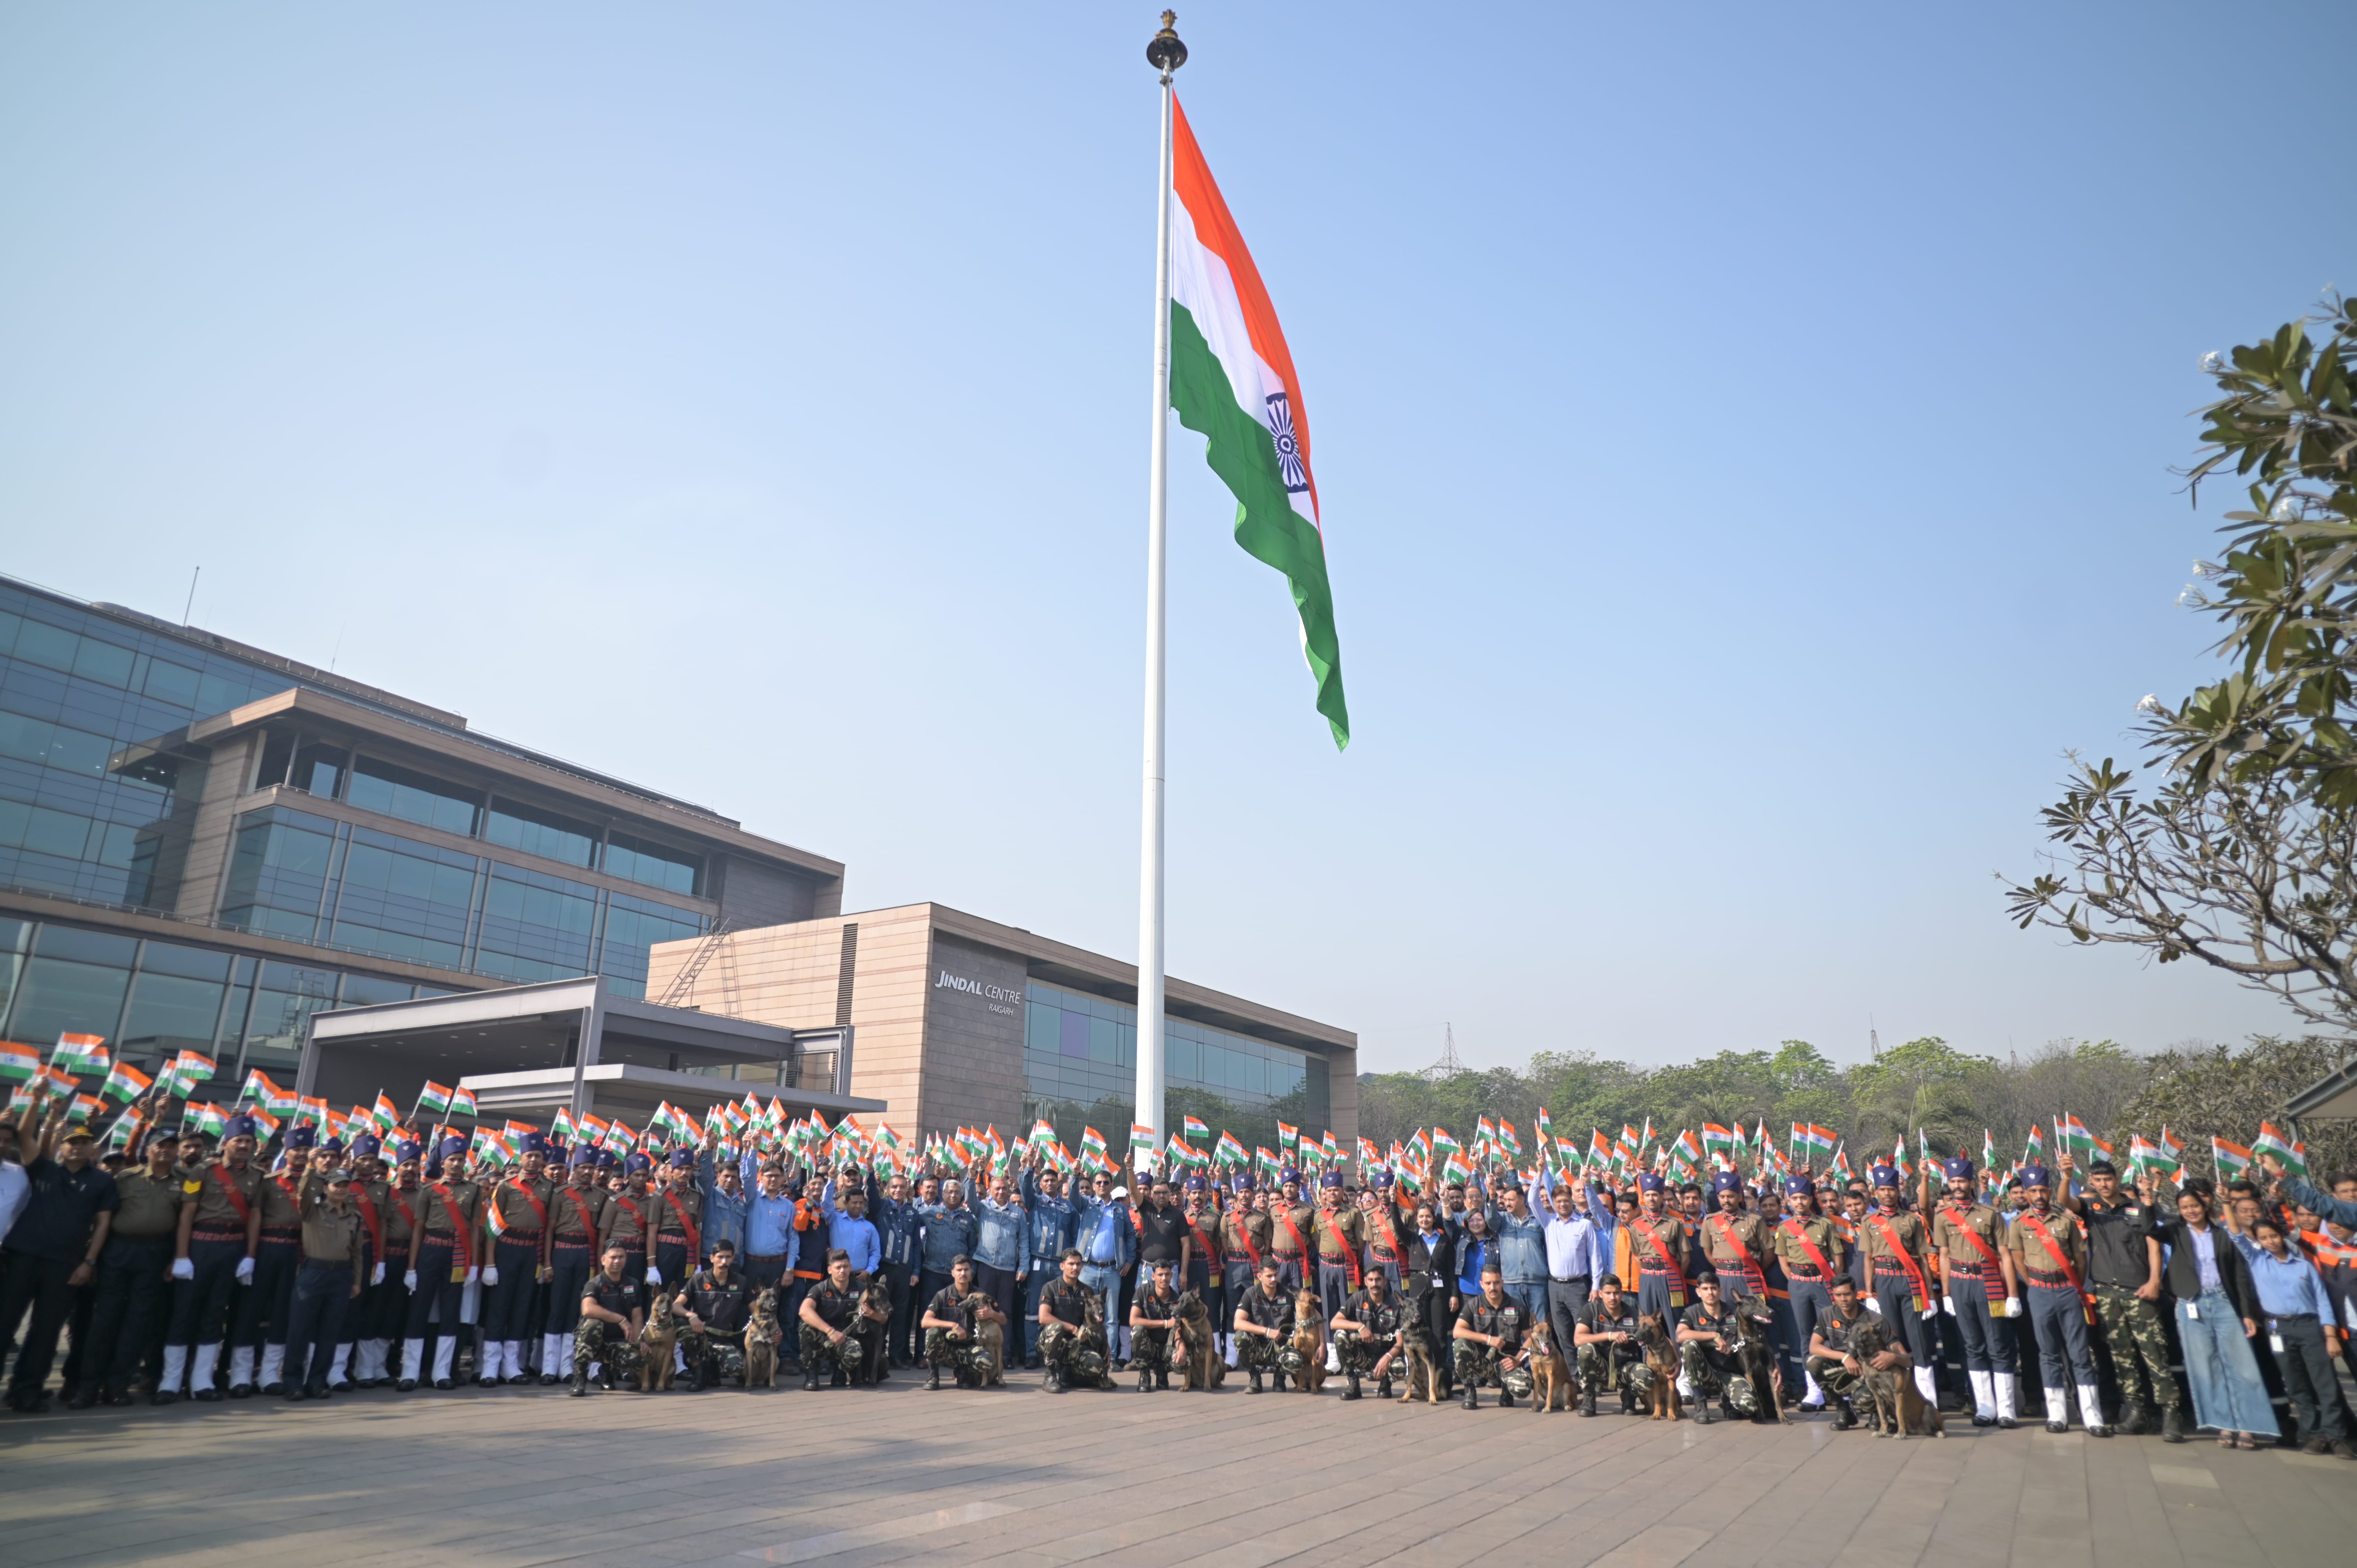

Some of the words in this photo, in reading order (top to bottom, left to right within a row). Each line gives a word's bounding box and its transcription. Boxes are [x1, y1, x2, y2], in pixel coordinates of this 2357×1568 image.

[935, 970, 982, 995] JINDAL
[985, 985, 1021, 1004] CENTRE
[988, 1003, 1014, 1016] RAIGARH
